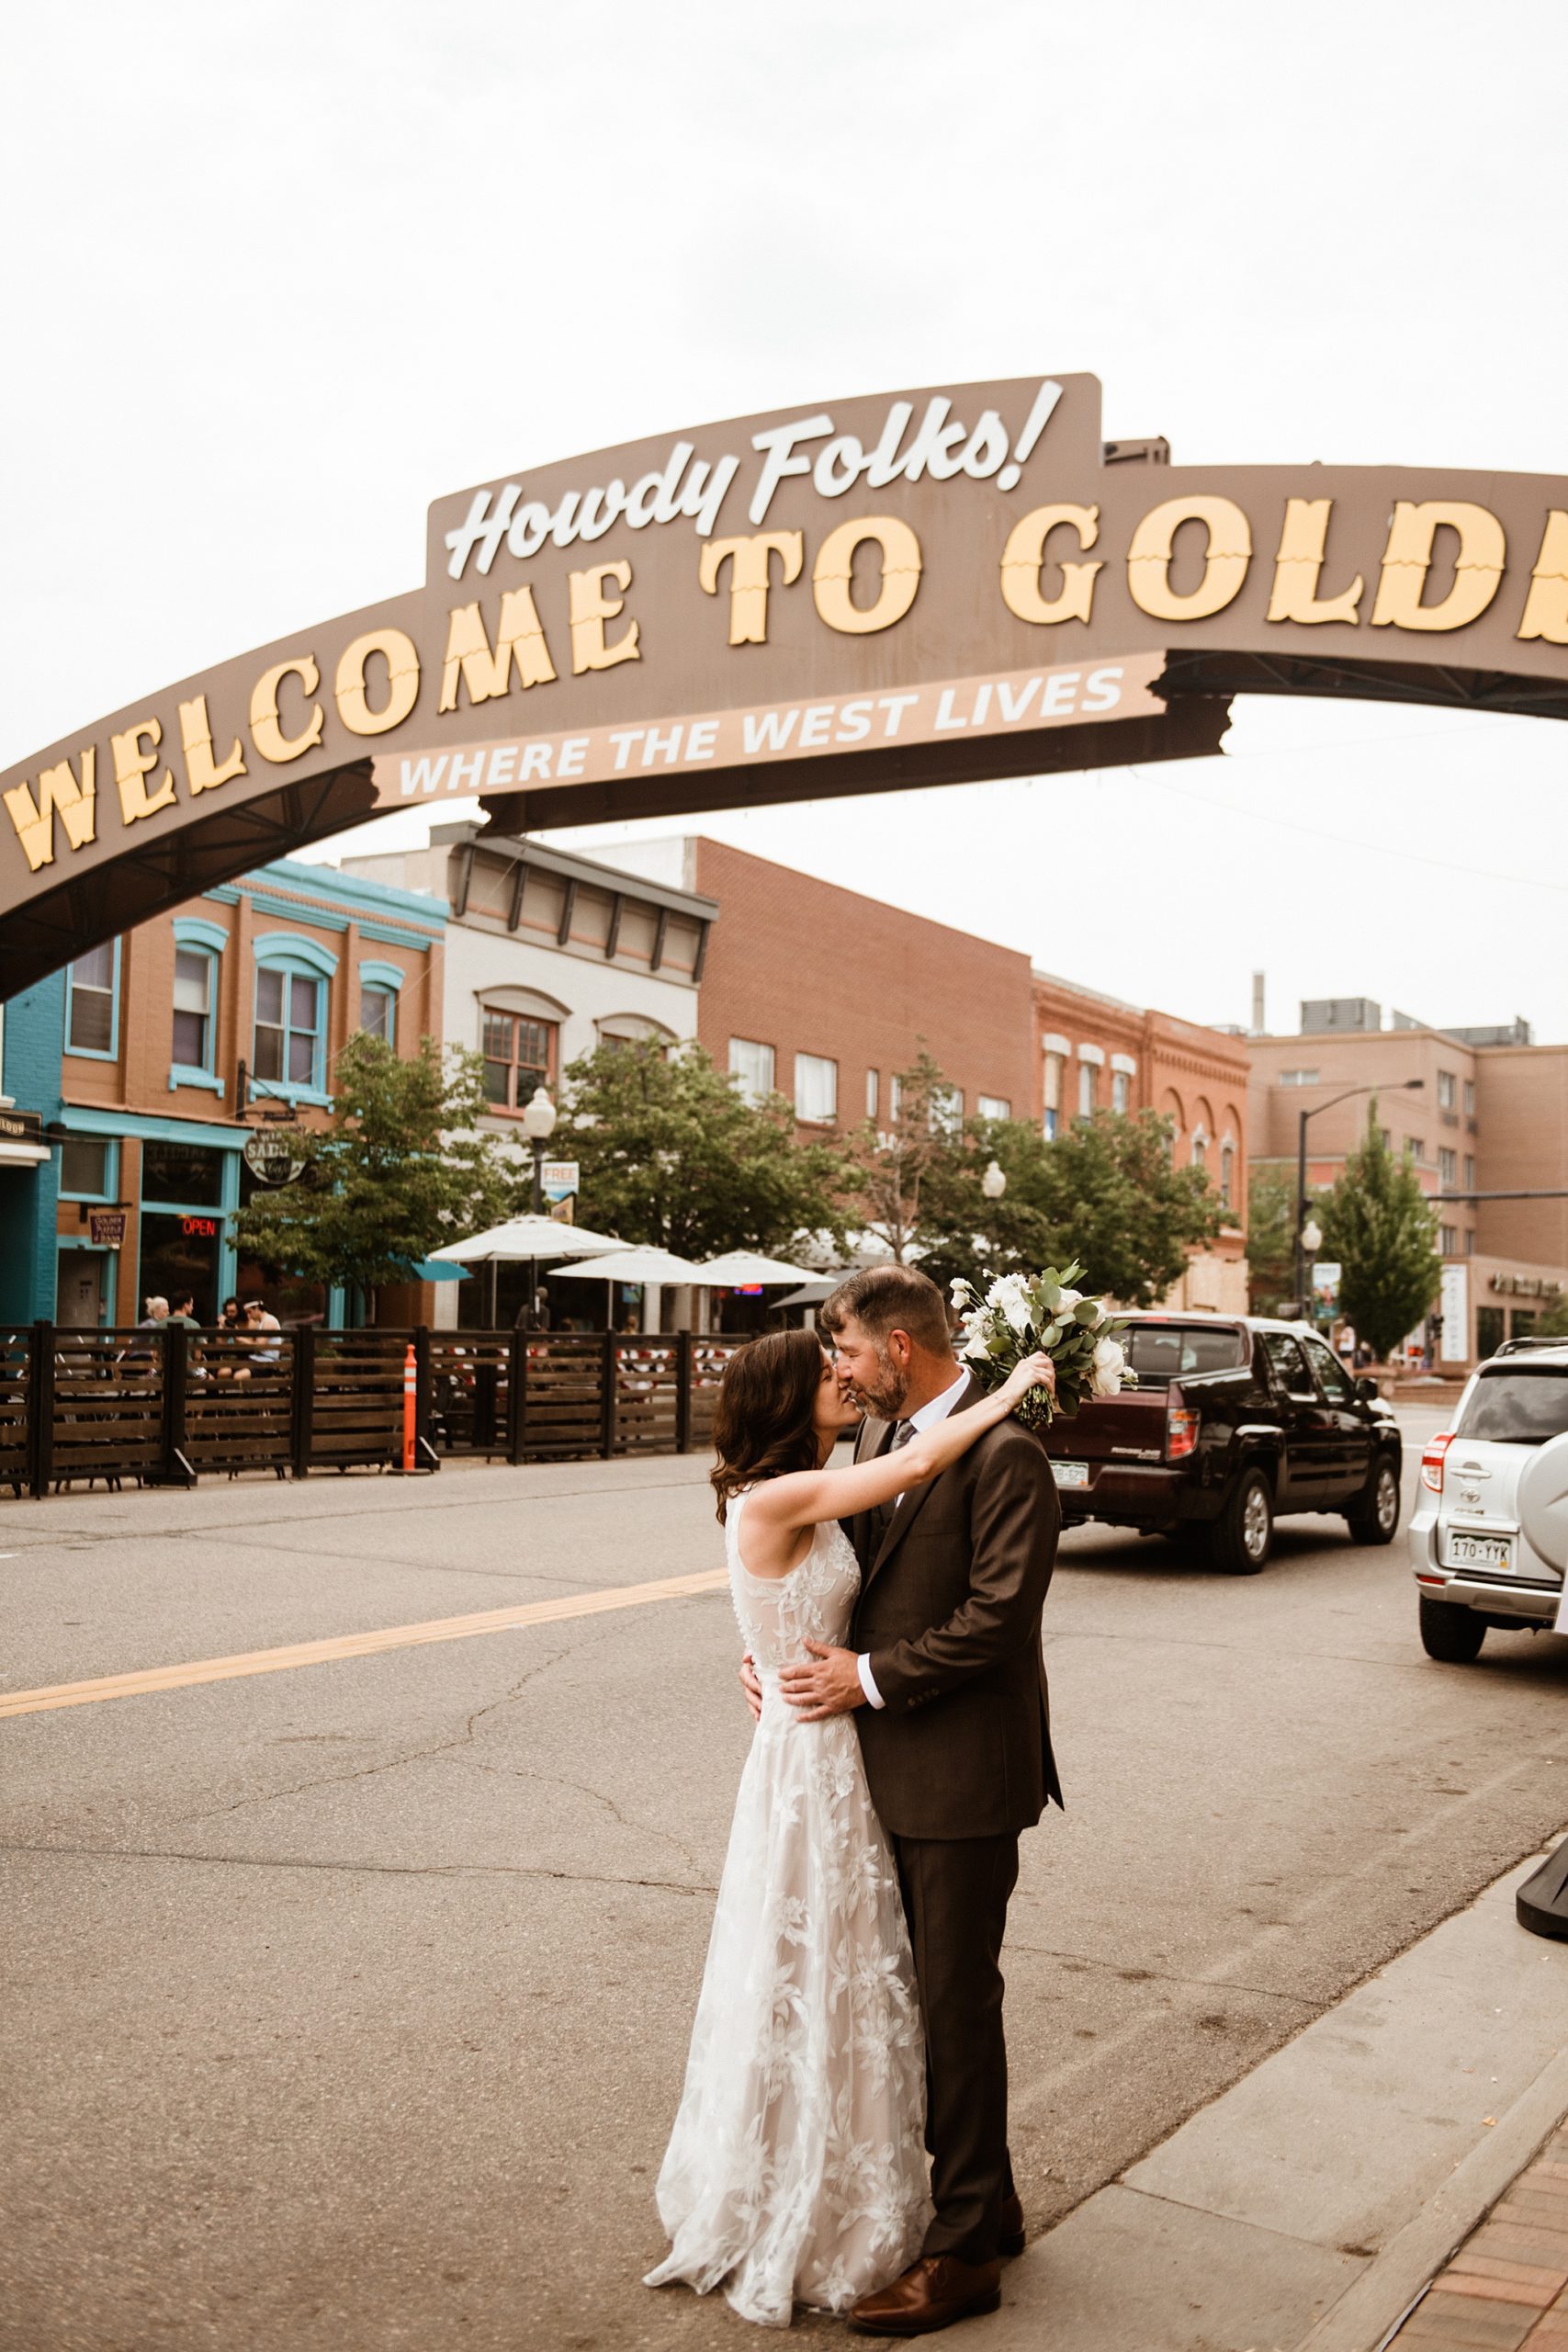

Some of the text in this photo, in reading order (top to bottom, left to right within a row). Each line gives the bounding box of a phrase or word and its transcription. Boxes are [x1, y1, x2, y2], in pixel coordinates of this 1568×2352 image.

[446, 379, 1063, 581] Howdy Folks!
[2, 559, 640, 873] WELCOME
[699, 514, 922, 646] TO
[398, 667, 1125, 797] WHERE THE WEST LIVES
[0, 1118, 25, 1134] LOON
[544, 1168, 575, 1180] FREE
[183, 1218, 216, 1236] OPEN
